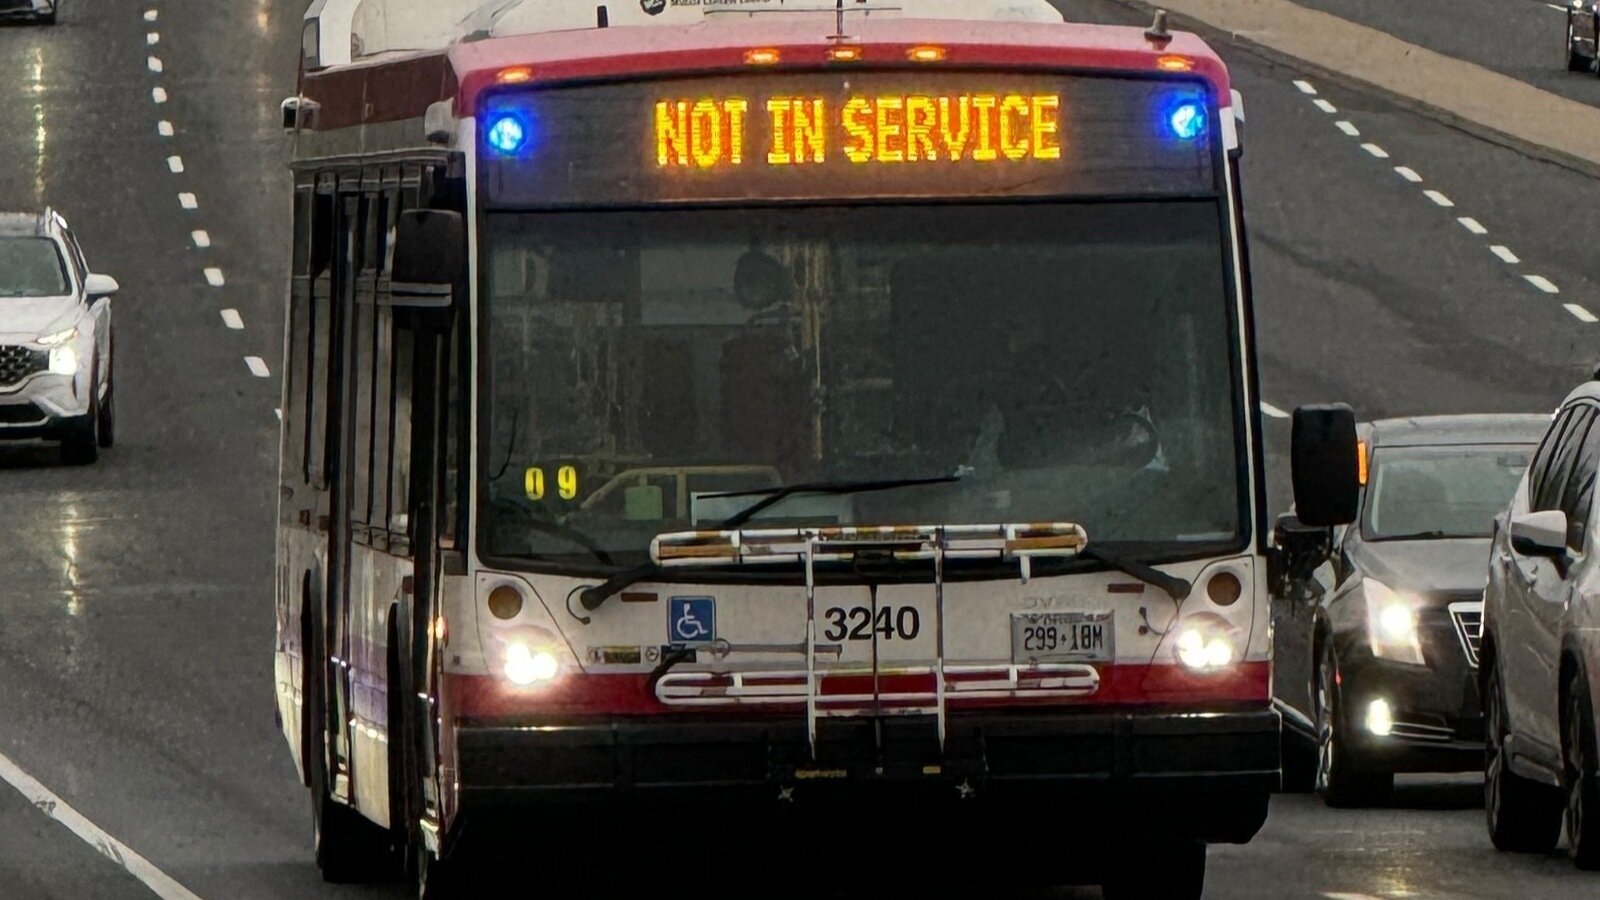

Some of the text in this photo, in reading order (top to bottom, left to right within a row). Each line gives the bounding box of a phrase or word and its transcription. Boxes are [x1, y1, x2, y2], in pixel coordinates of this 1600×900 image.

[655, 95, 1062, 166] NOT IN SERVICE
[824, 606, 920, 641] 3240
